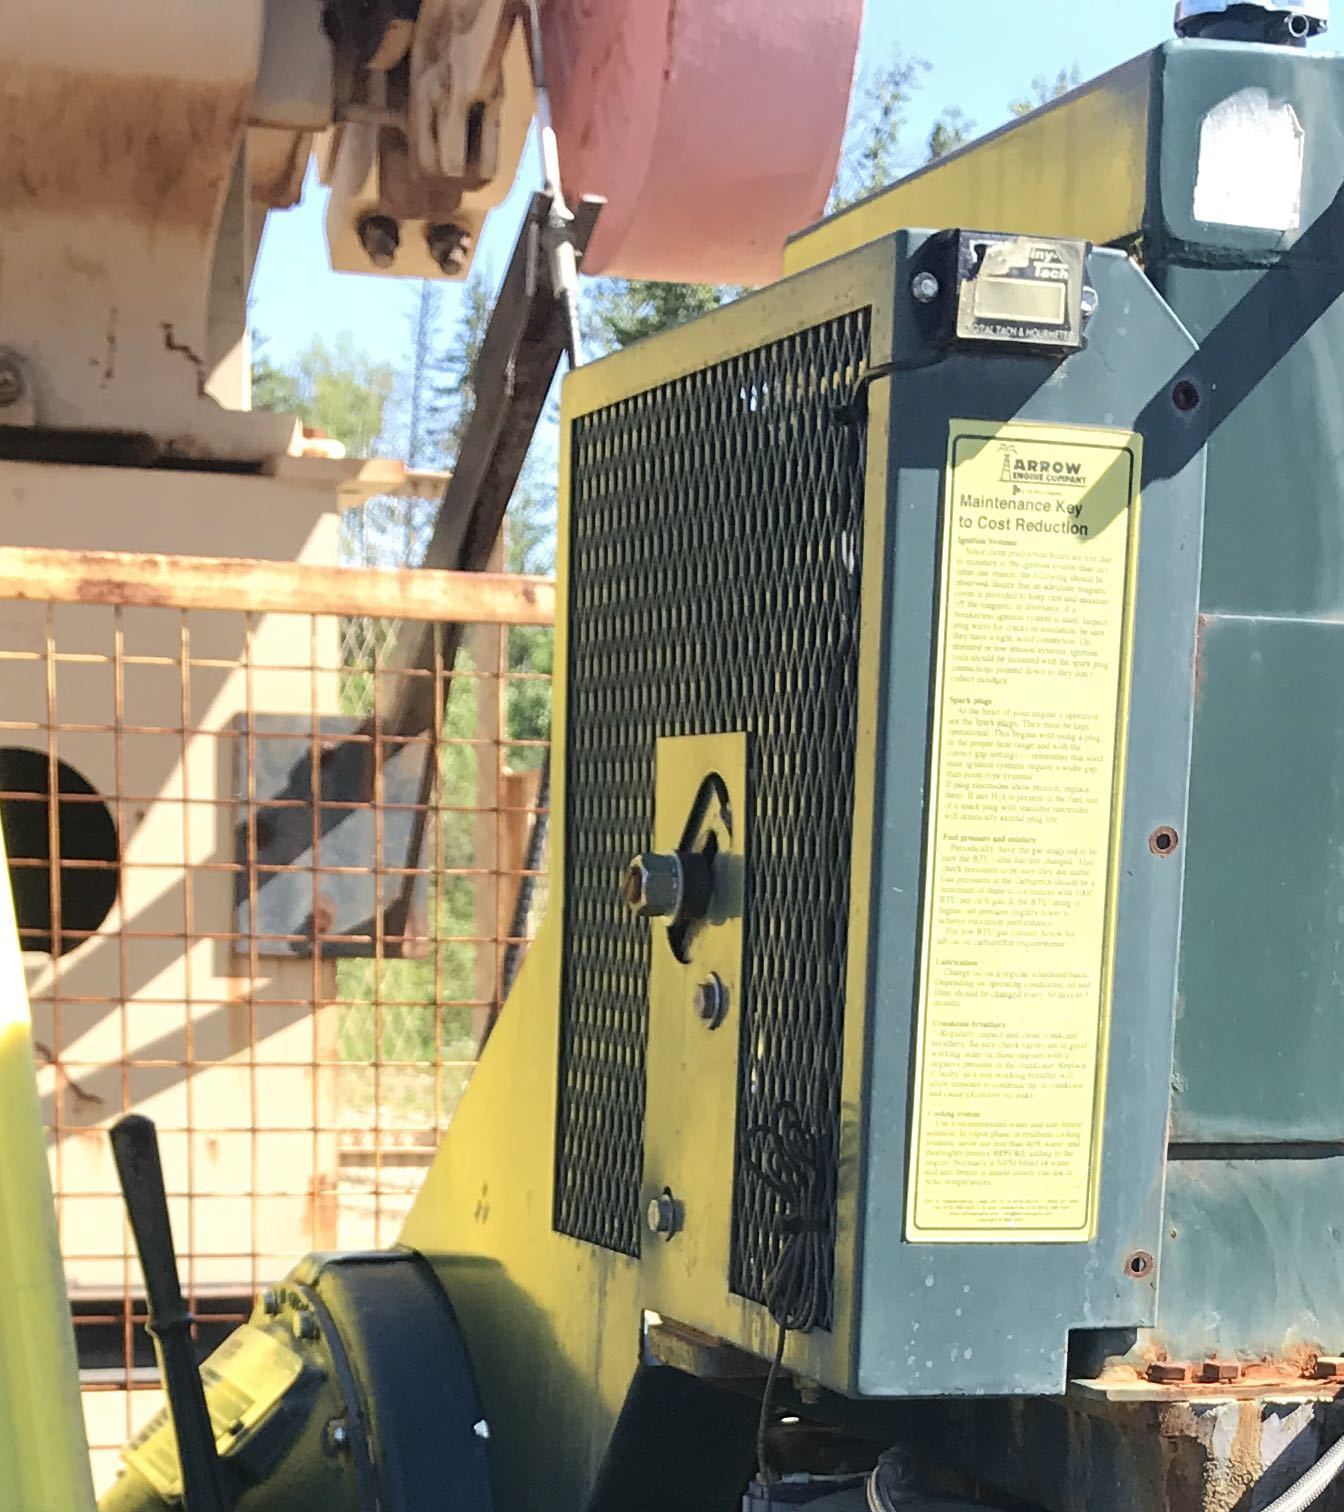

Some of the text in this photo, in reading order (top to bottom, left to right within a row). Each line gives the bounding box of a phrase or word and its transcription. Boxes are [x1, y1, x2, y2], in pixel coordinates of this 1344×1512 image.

[1033, 261, 1069, 279] Tach
[996, 325, 1017, 337] TACH
[1018, 327, 1025, 338] &
[1014, 459, 1081, 475] ARROW
[1013, 472, 1086, 485] ENGINE COMPANY
[960, 494, 1083, 518] Maintenance Key
[959, 516, 1089, 536] to Cost Reduction
